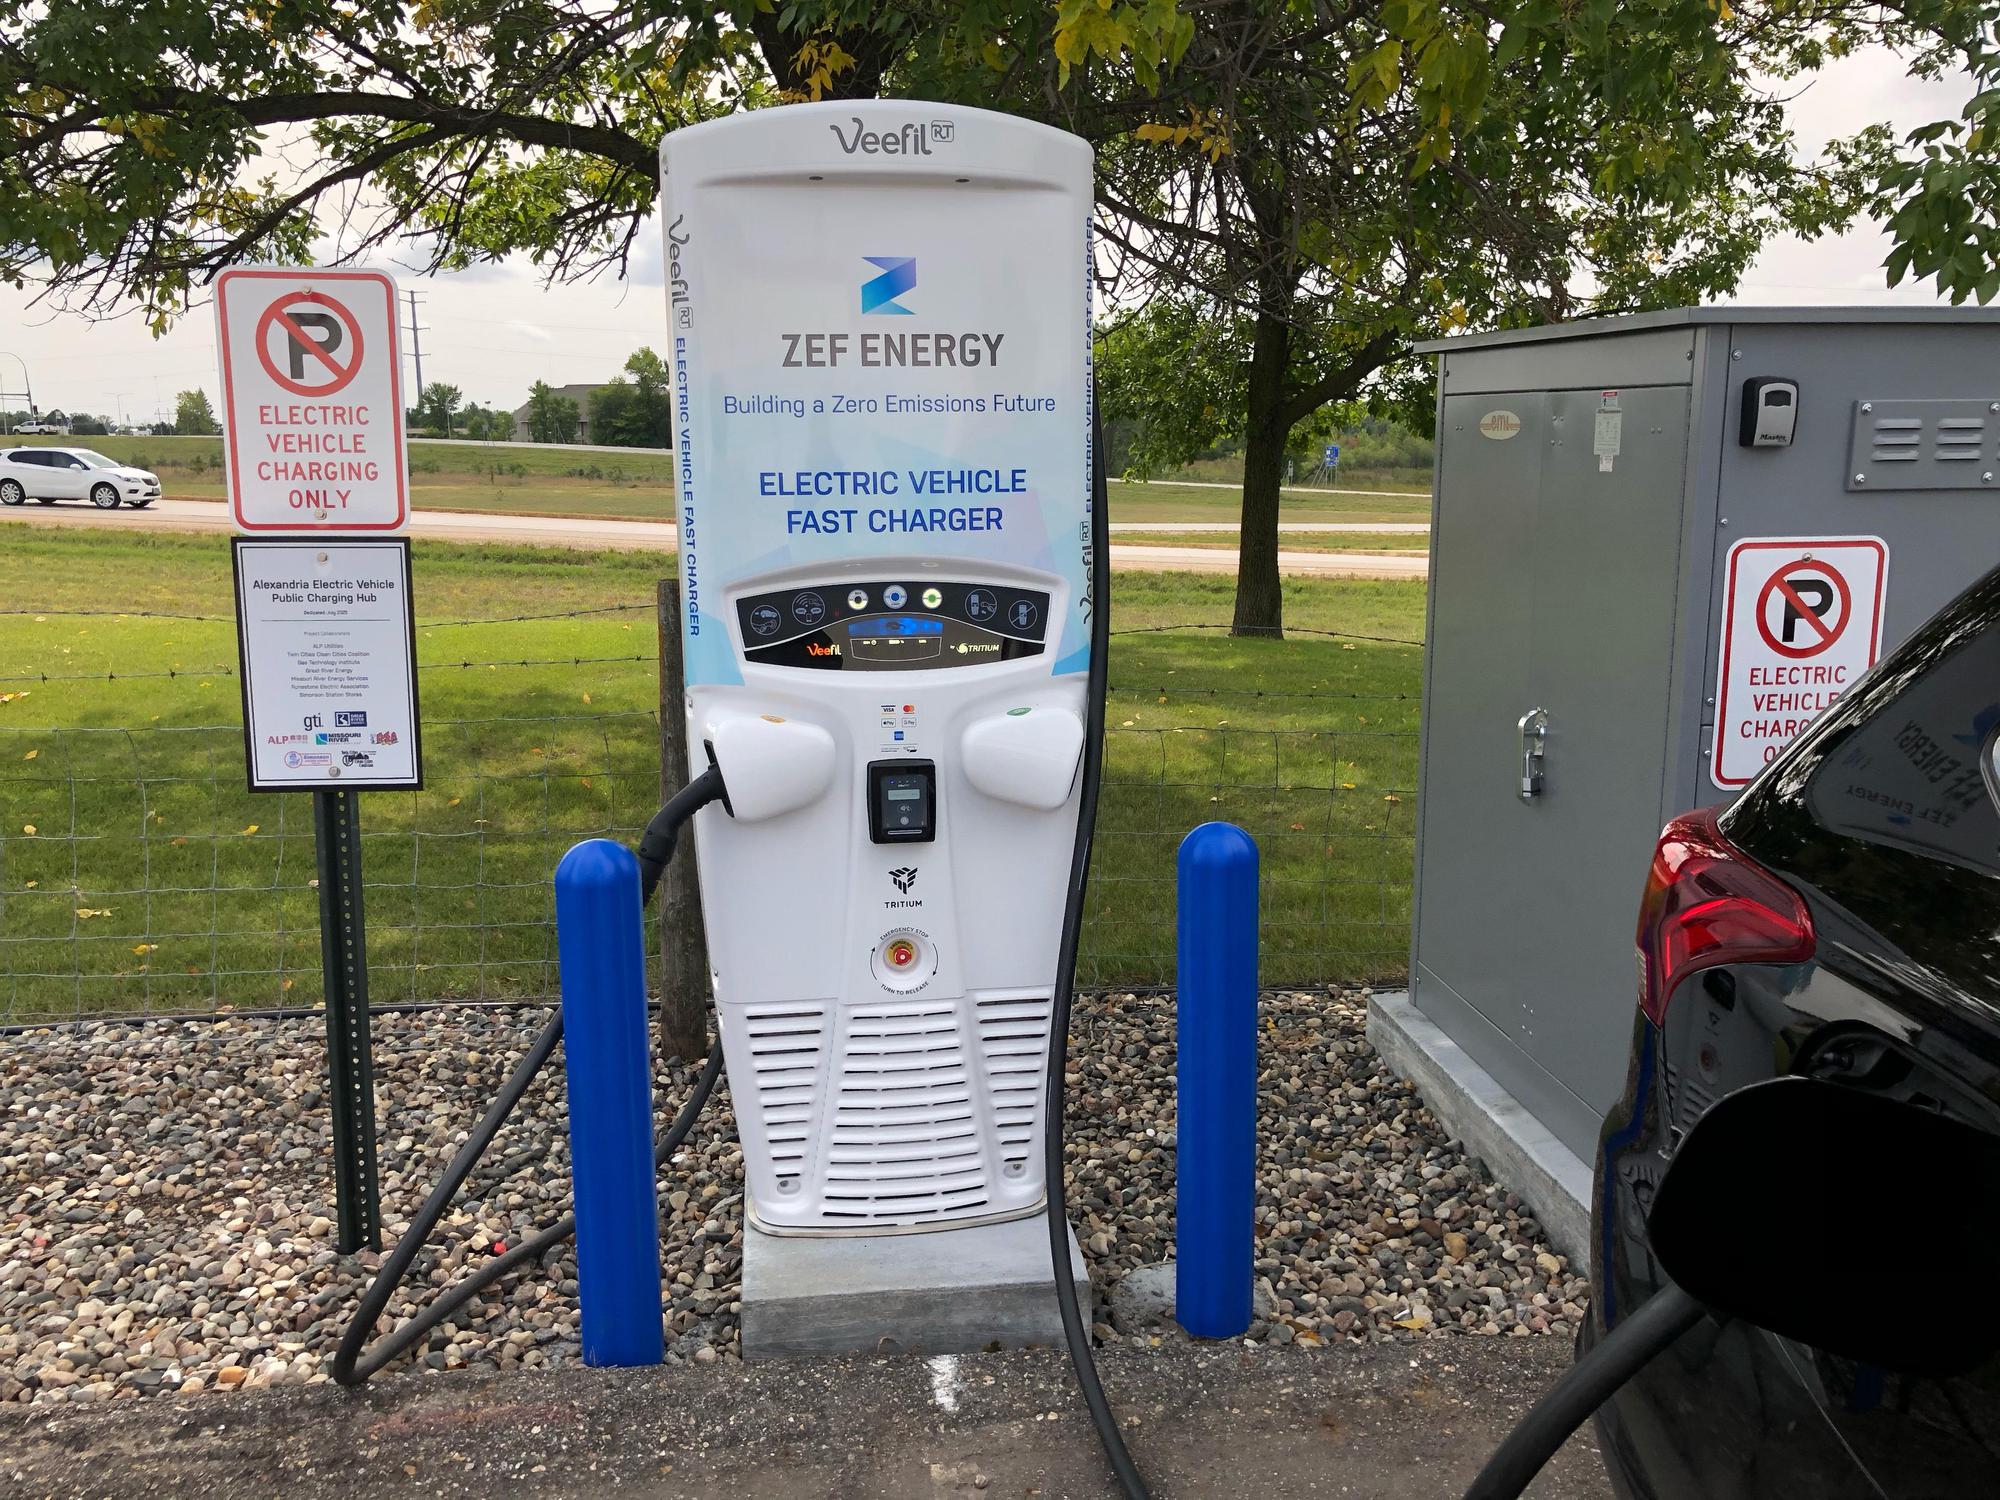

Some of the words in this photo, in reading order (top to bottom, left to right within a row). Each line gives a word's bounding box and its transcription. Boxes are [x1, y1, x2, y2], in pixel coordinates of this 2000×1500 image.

[830, 118, 932, 156] Veefil
[932, 121, 953, 141] RT
[668, 214, 690, 309] Veefil
[680, 308, 691, 328] RT
[782, 334, 848, 368] ZEF
[861, 334, 1004, 367] ENERGY
[676, 338, 689, 423] ELECTRIC
[259, 406, 369, 425] ELECTRIC
[724, 396, 805, 418] Building
[813, 400, 824, 414] a
[832, 396, 877, 413] Zero
[886, 395, 985, 413] Emissions
[994, 394, 1056, 412] Future
[267, 434, 366, 453] VEHICLE
[258, 461, 378, 481] CHARGING
[681, 428, 693, 501] VEHICLE
[760, 471, 898, 496] ELECTRIC
[909, 470, 1026, 494] VEHICLE
[289, 490, 351, 508] ONLY
[684, 507, 696, 549] FAST
[788, 510, 858, 534] FAST
[868, 508, 1002, 532] CHARGER
[1082, 523, 1089, 540] RT
[253, 580, 309, 589] Alexandria
[313, 580, 353, 589] Electric
[357, 580, 394, 589] Vehicle
[272, 594, 304, 602] Public
[307, 594, 353, 604] Charging
[357, 594, 377, 602] Hub
[687, 554, 699, 636] CHARGER
[807, 643, 841, 656] Veefil
[1750, 666, 1846, 685] ELECTRIC
[304, 713, 322, 731] gti
[268, 736, 289, 744] ALP
[1844, 785, 1915, 814] ENERGY
[885, 900, 922, 908] TRITIUM
[880, 927, 914, 940] EMERGENCY
[915, 928, 929, 938] STOP
[880, 984, 895, 994] TURN
[906, 981, 929, 994] RELEASE
